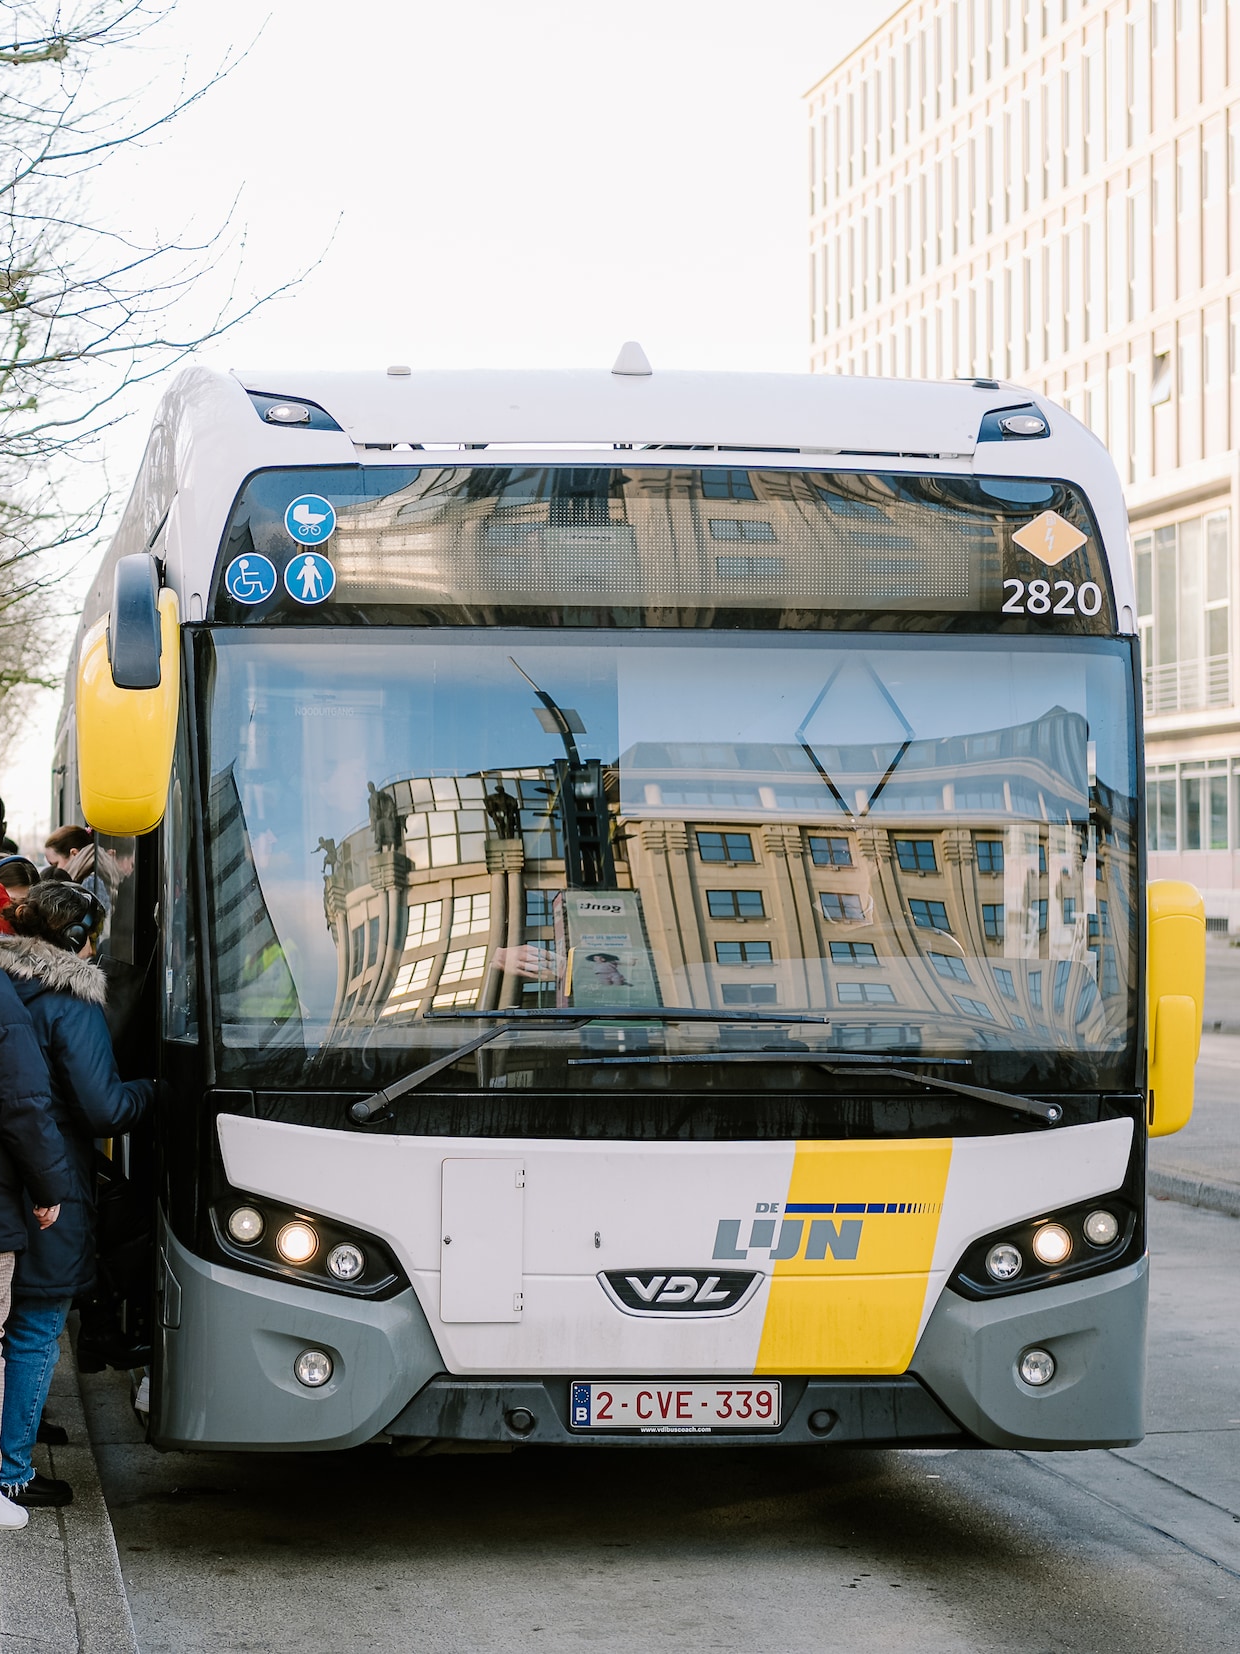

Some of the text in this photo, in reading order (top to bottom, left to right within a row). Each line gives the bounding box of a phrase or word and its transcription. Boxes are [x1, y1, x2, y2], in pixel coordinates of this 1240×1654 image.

[1001, 578, 1103, 617] 2820
[755, 1202, 780, 1214] DE
[711, 1219, 864, 1261] LIJN
[624, 1276, 732, 1304] VDL
[575, 1407, 588, 1421] B
[640, 1426, 712, 1434] www.vdlbuscoach.com
